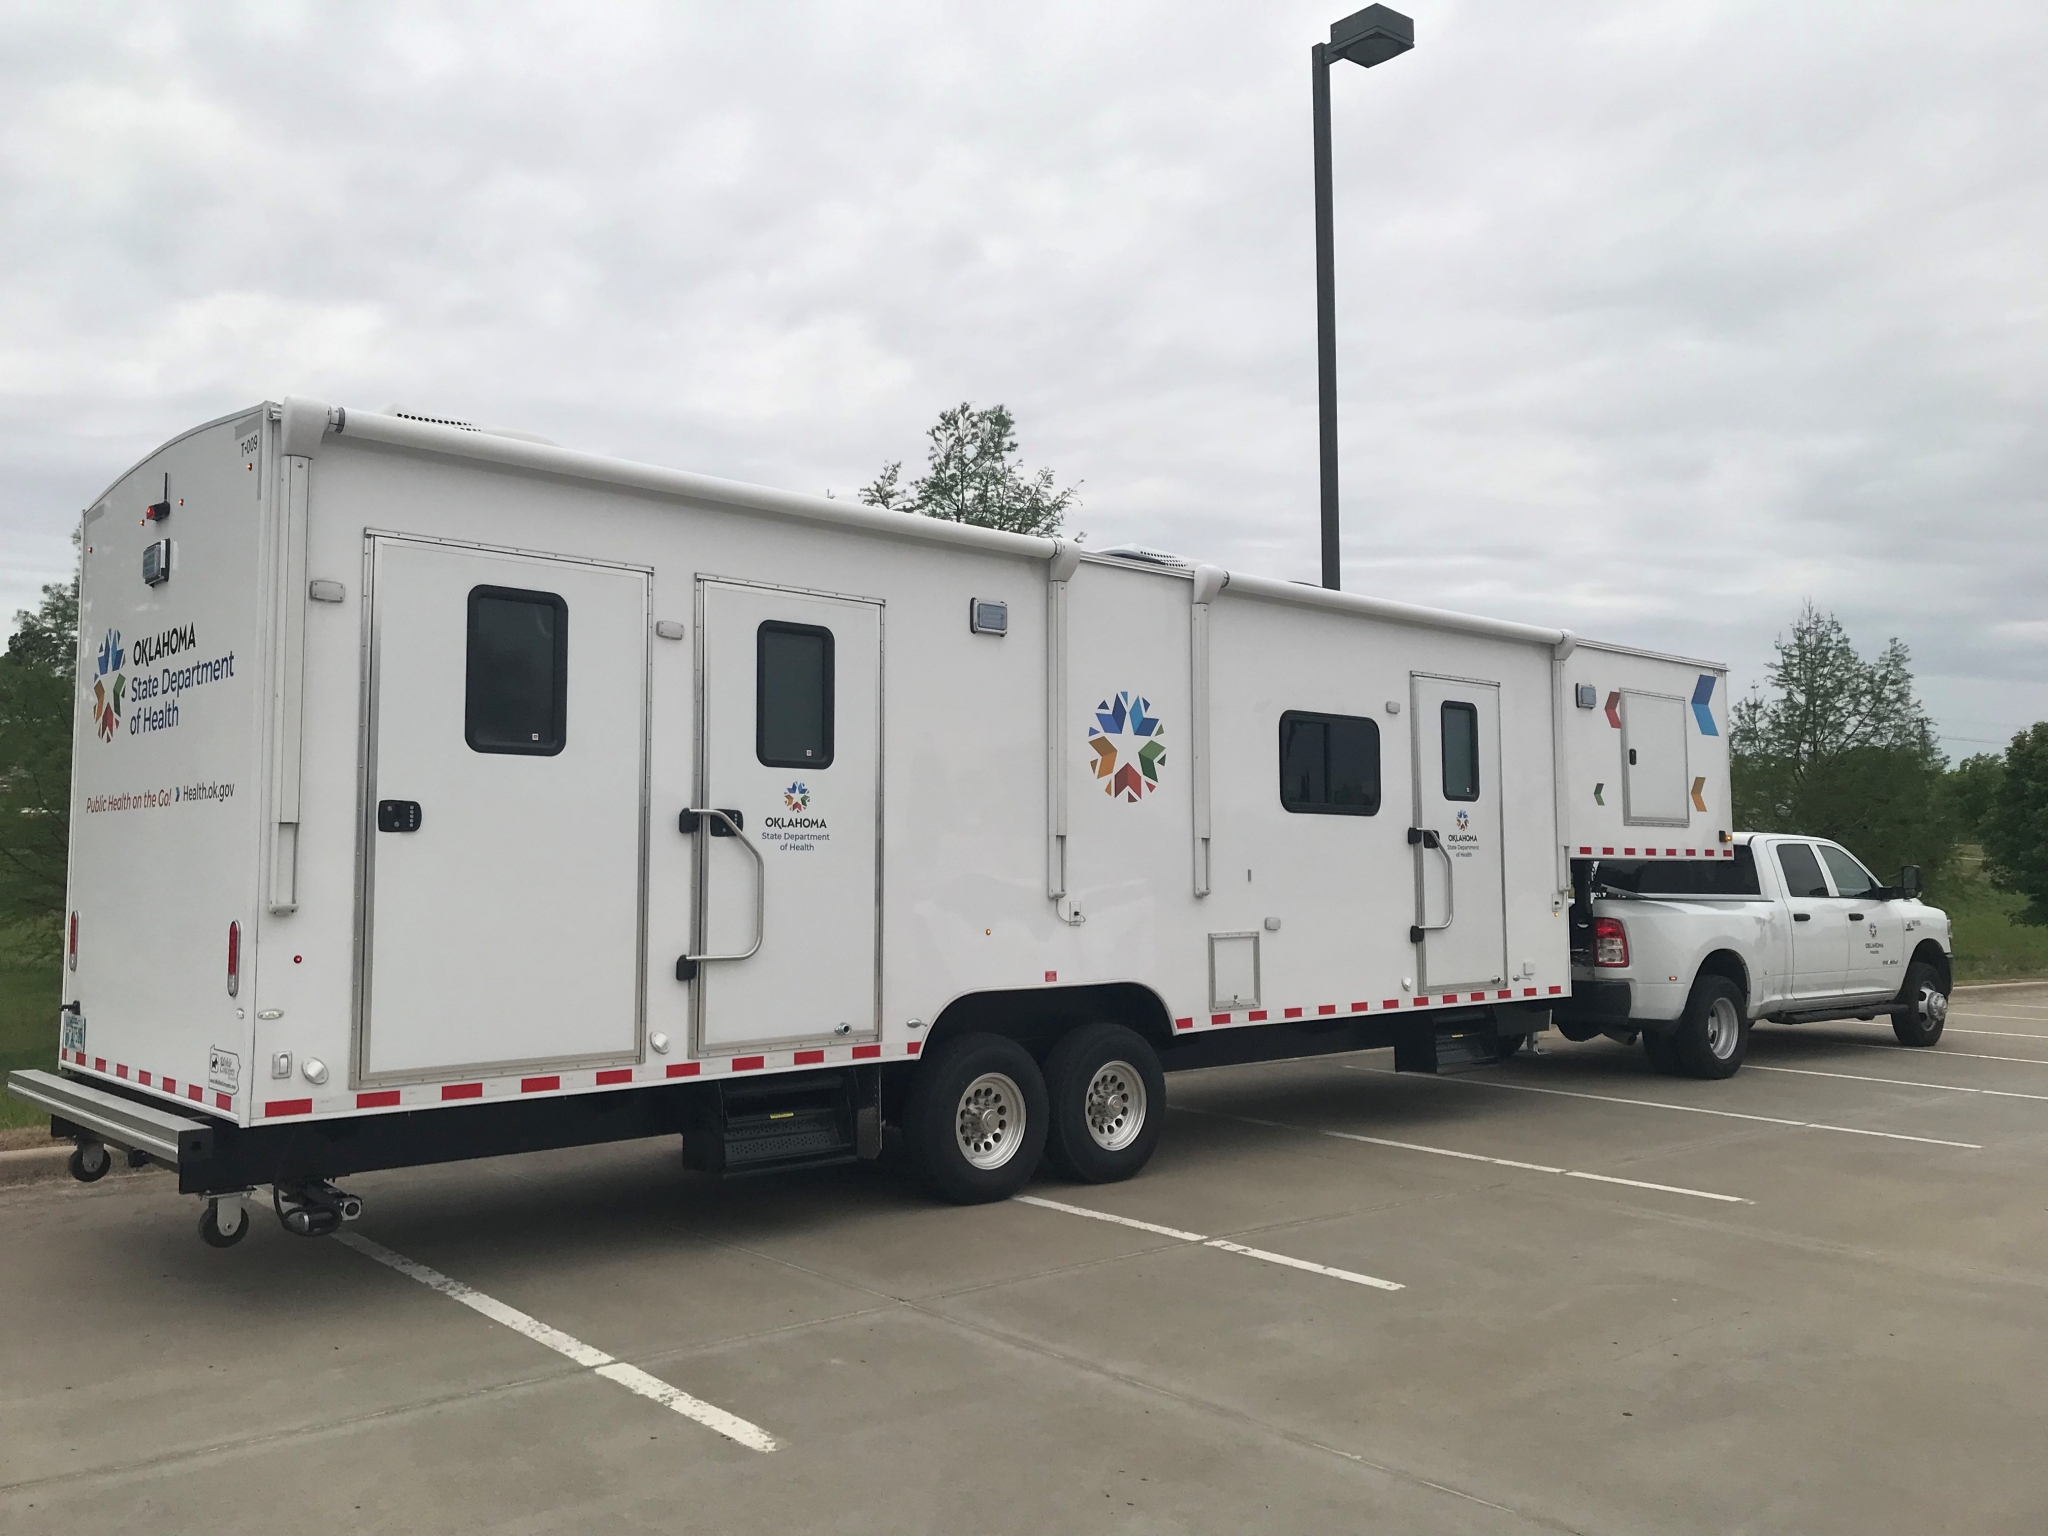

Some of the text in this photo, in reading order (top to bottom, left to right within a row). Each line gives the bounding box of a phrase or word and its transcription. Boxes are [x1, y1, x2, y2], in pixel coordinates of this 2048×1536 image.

[241, 434, 258, 457] T-009
[133, 622, 196, 667] OKLAHOMA
[131, 651, 235, 702] State Department
[130, 699, 179, 735] of Health
[86, 781, 235, 813] Public Health on the Go! Health.ok.gov
[765, 817, 828, 829] OKLAHOMA
[761, 832, 830, 841] State Department
[780, 843, 815, 851] of Health
[1448, 834, 1478, 842] OKLAHOMA
